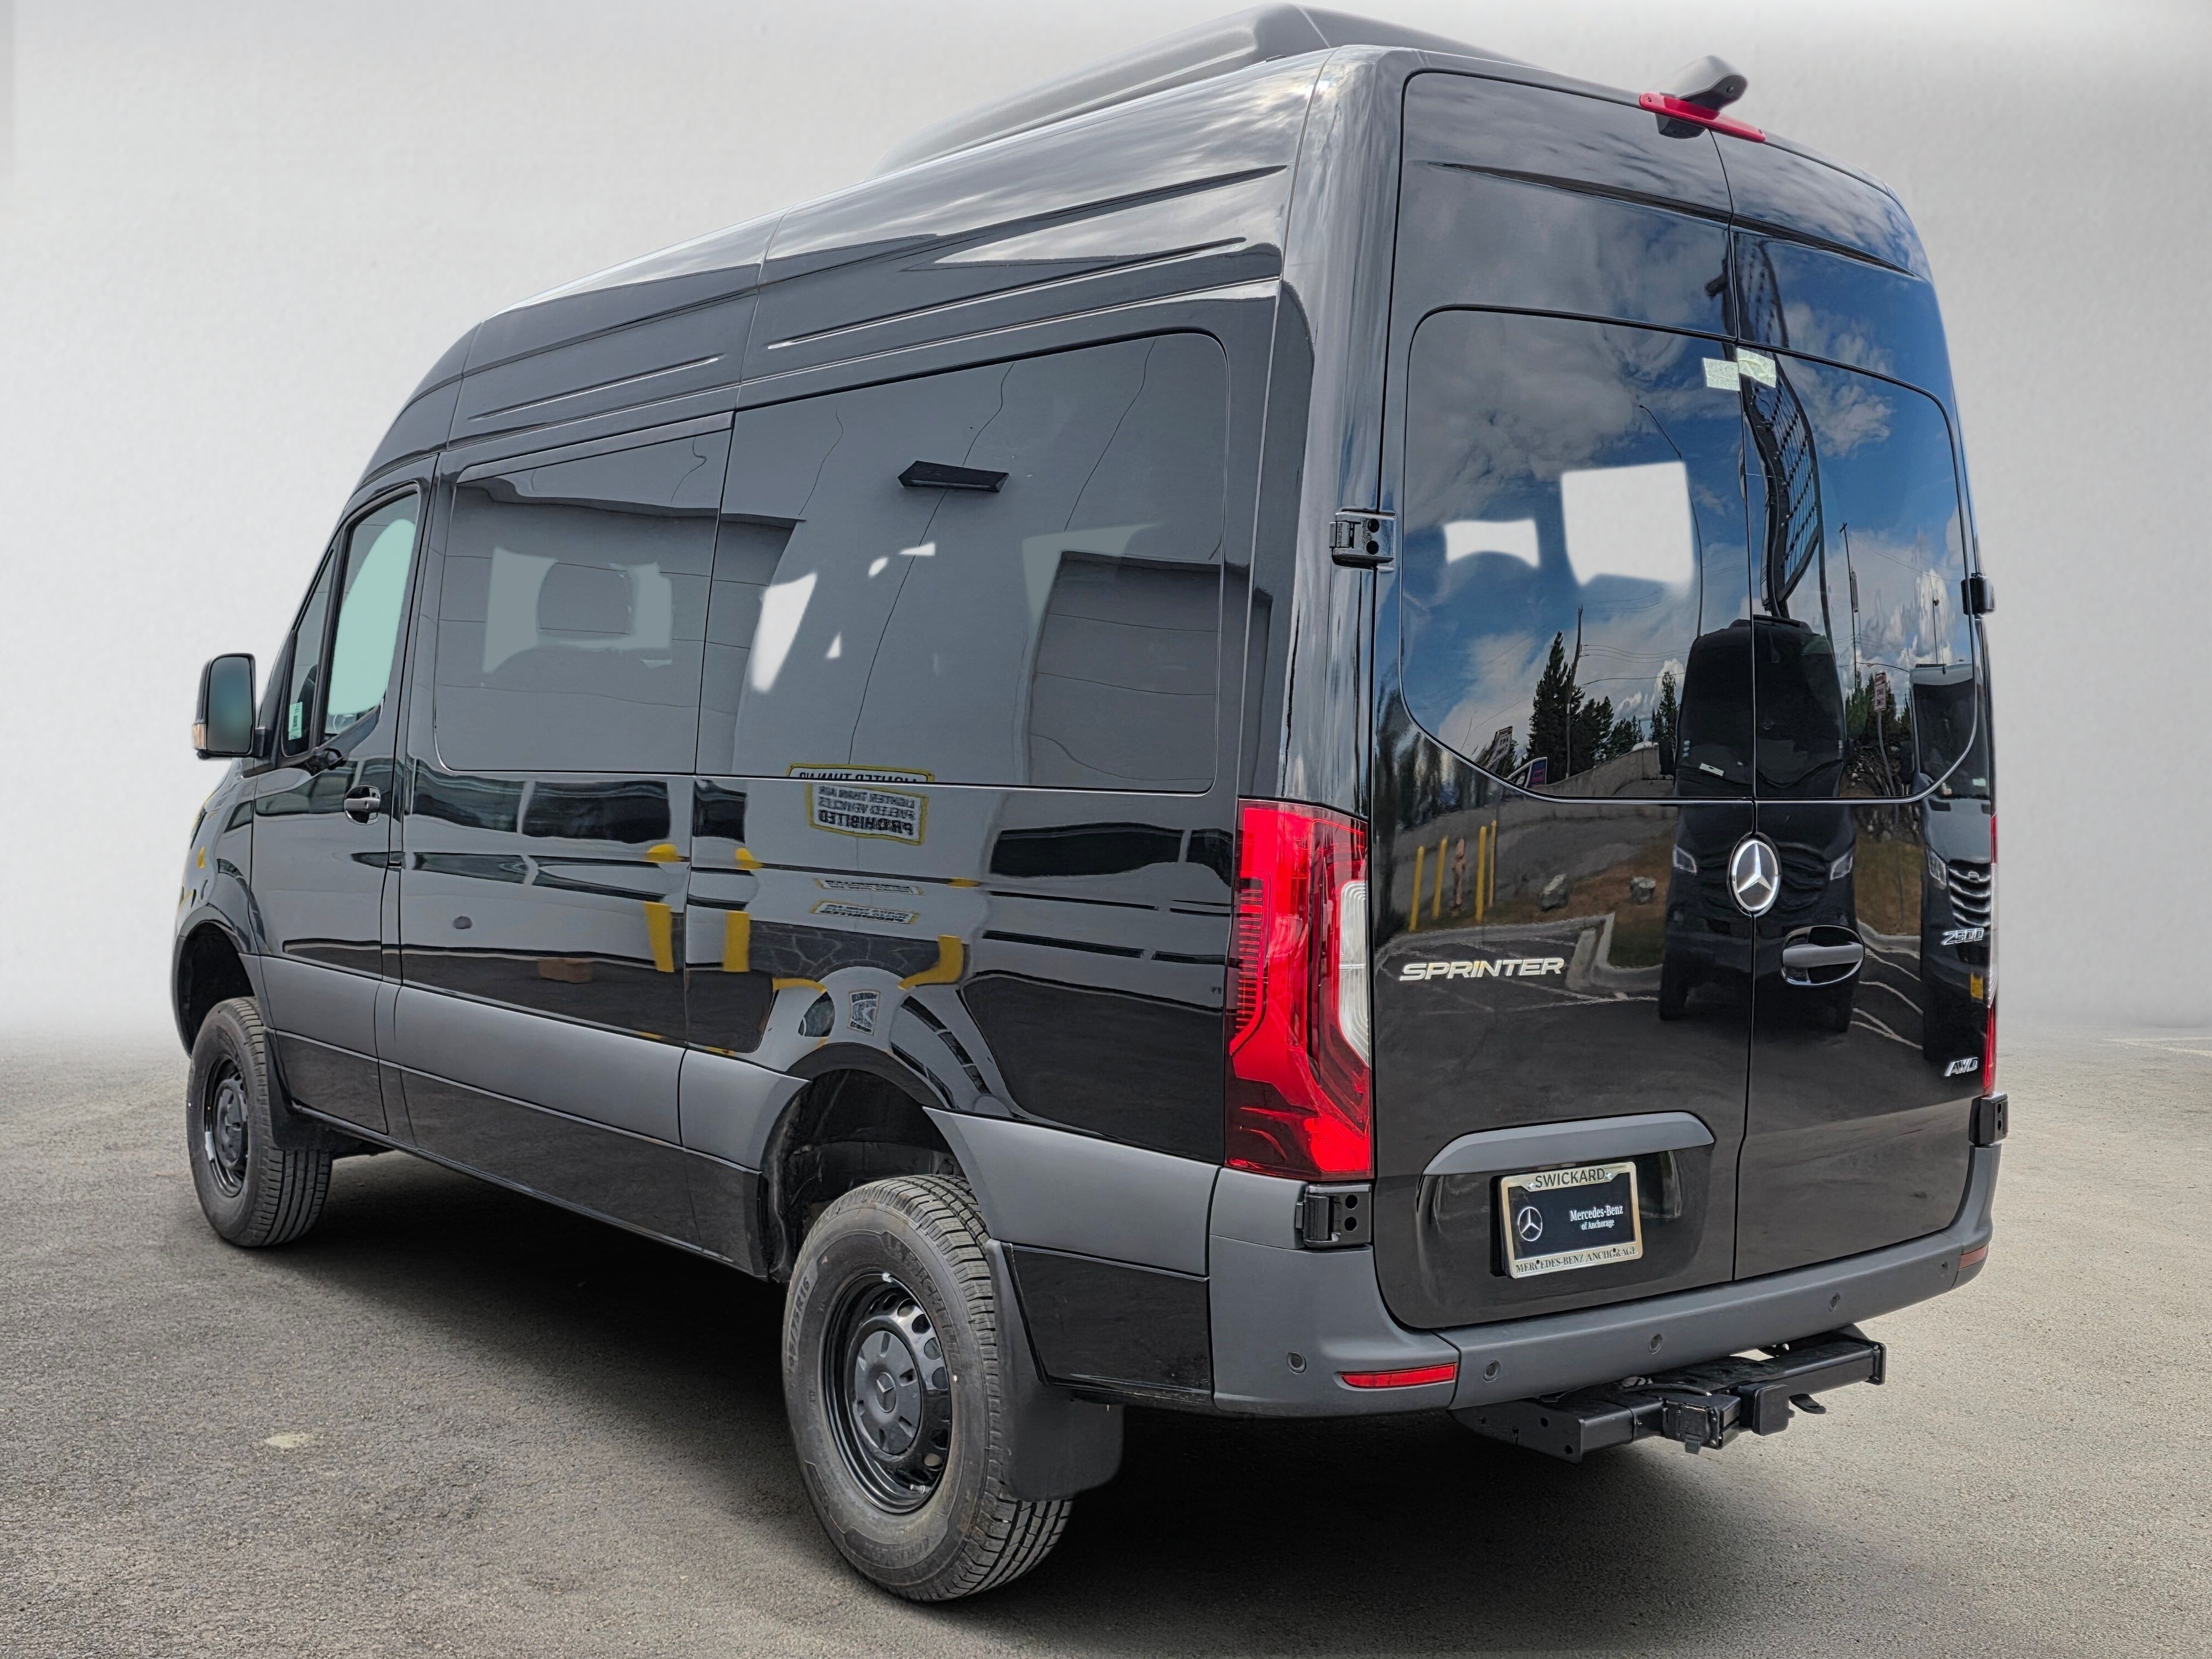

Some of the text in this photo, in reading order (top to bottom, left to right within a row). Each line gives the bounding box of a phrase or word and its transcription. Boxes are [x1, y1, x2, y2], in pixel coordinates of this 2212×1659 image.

[1942, 927, 1984, 945] 2500
[1399, 957, 1564, 981] SPRINTER
[1944, 1057, 1979, 1077] AWD
[1535, 1167, 1606, 1189] SWICKARD
[1569, 1204, 1624, 1222] Mercedes-Benz
[1582, 1219, 1615, 1230] of Anchorage
[1516, 1246, 1637, 1274] MERCEDES-BENZ ANCHORAGE
